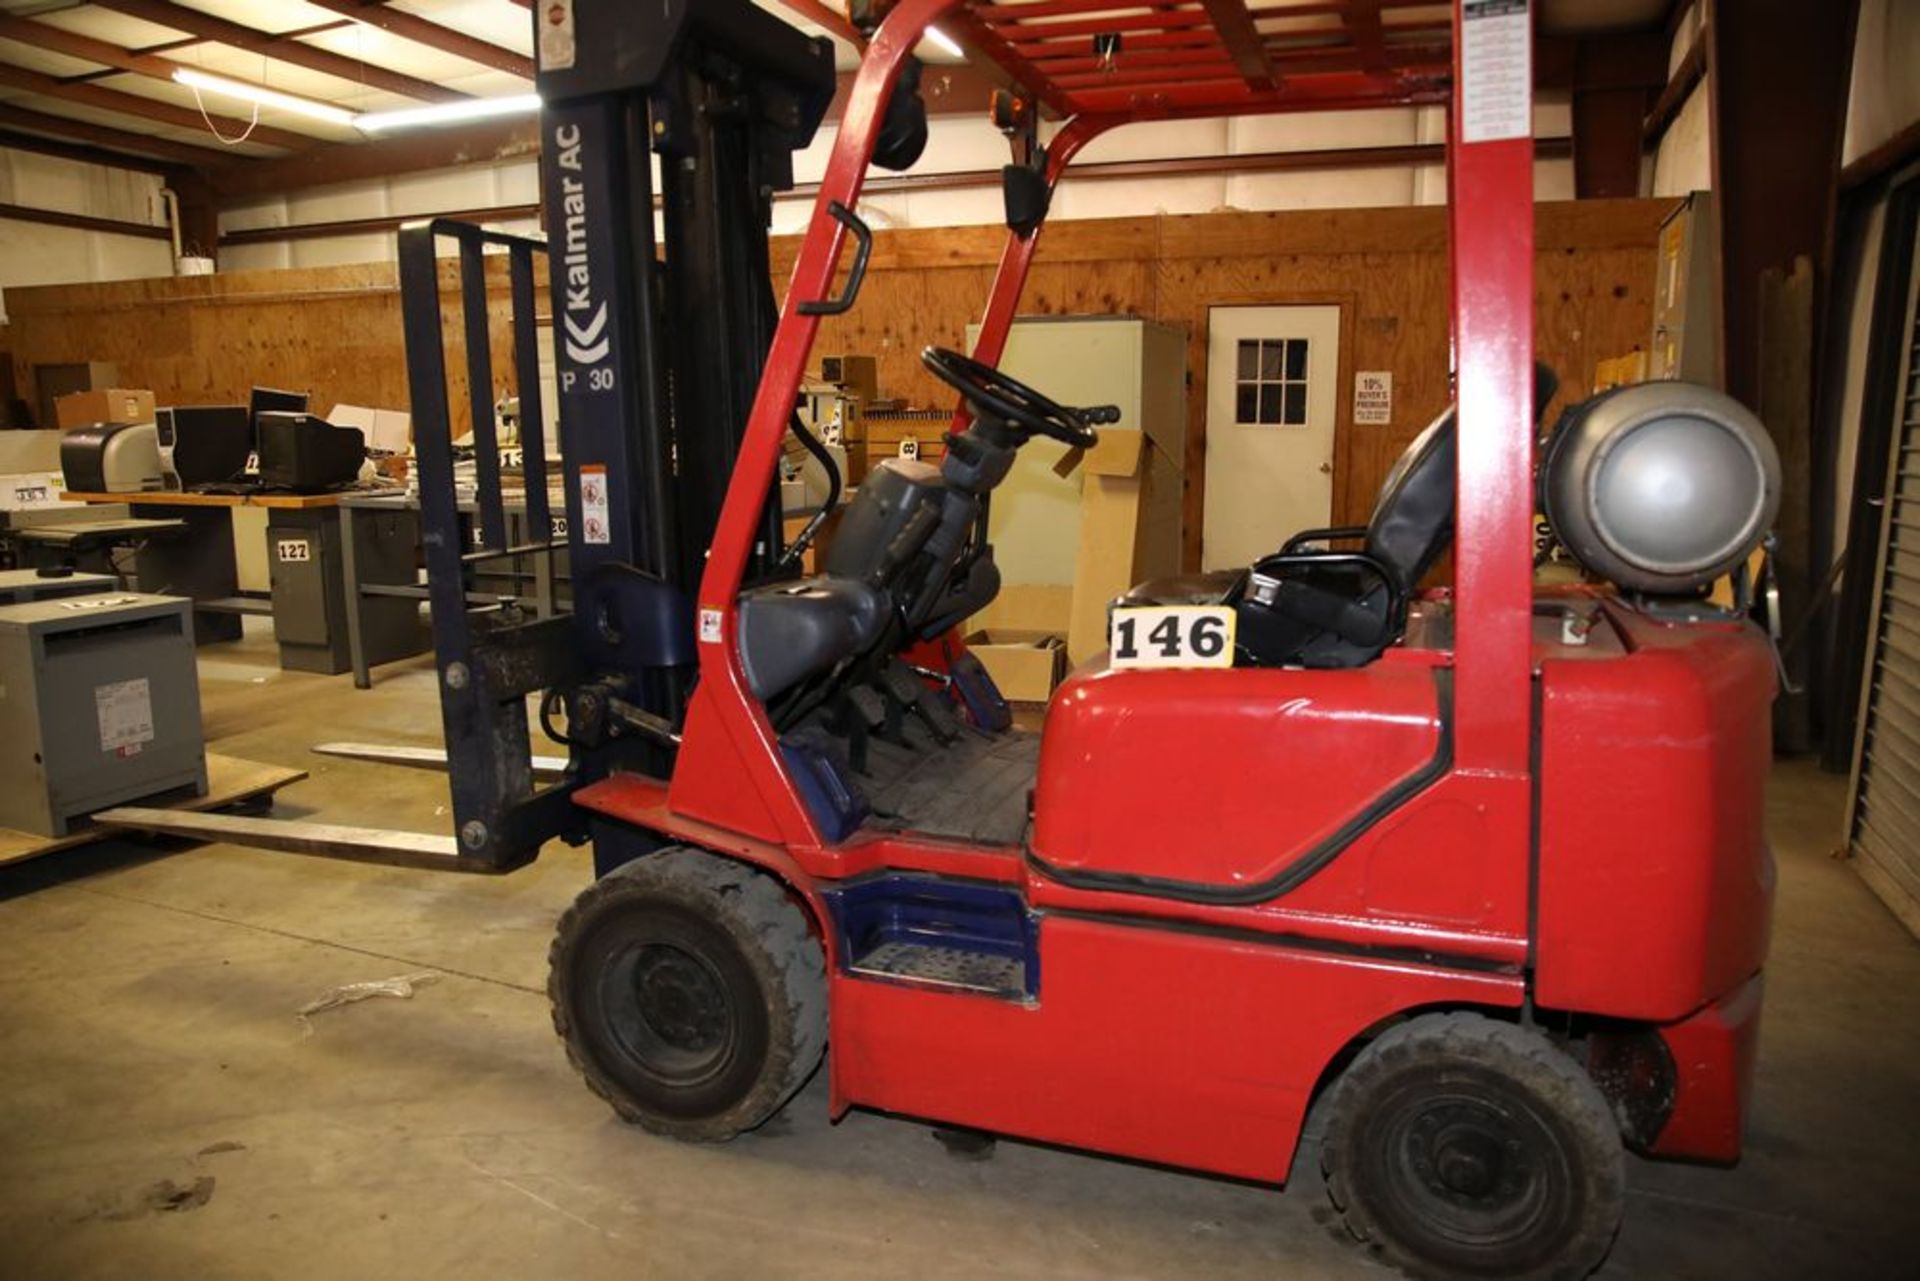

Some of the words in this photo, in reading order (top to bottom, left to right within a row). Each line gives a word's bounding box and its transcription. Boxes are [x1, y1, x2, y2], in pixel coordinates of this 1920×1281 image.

[556, 124, 582, 170] AC
[563, 177, 590, 311] Kalmar
[560, 371, 577, 392] P
[589, 368, 614, 391] 30
[1363, 378, 1384, 391] 10%
[1356, 400, 1389, 409] PREMIUM
[1357, 391, 1388, 400] BUYER'S
[280, 544, 307, 559] 127
[1116, 615, 1225, 658] 146
